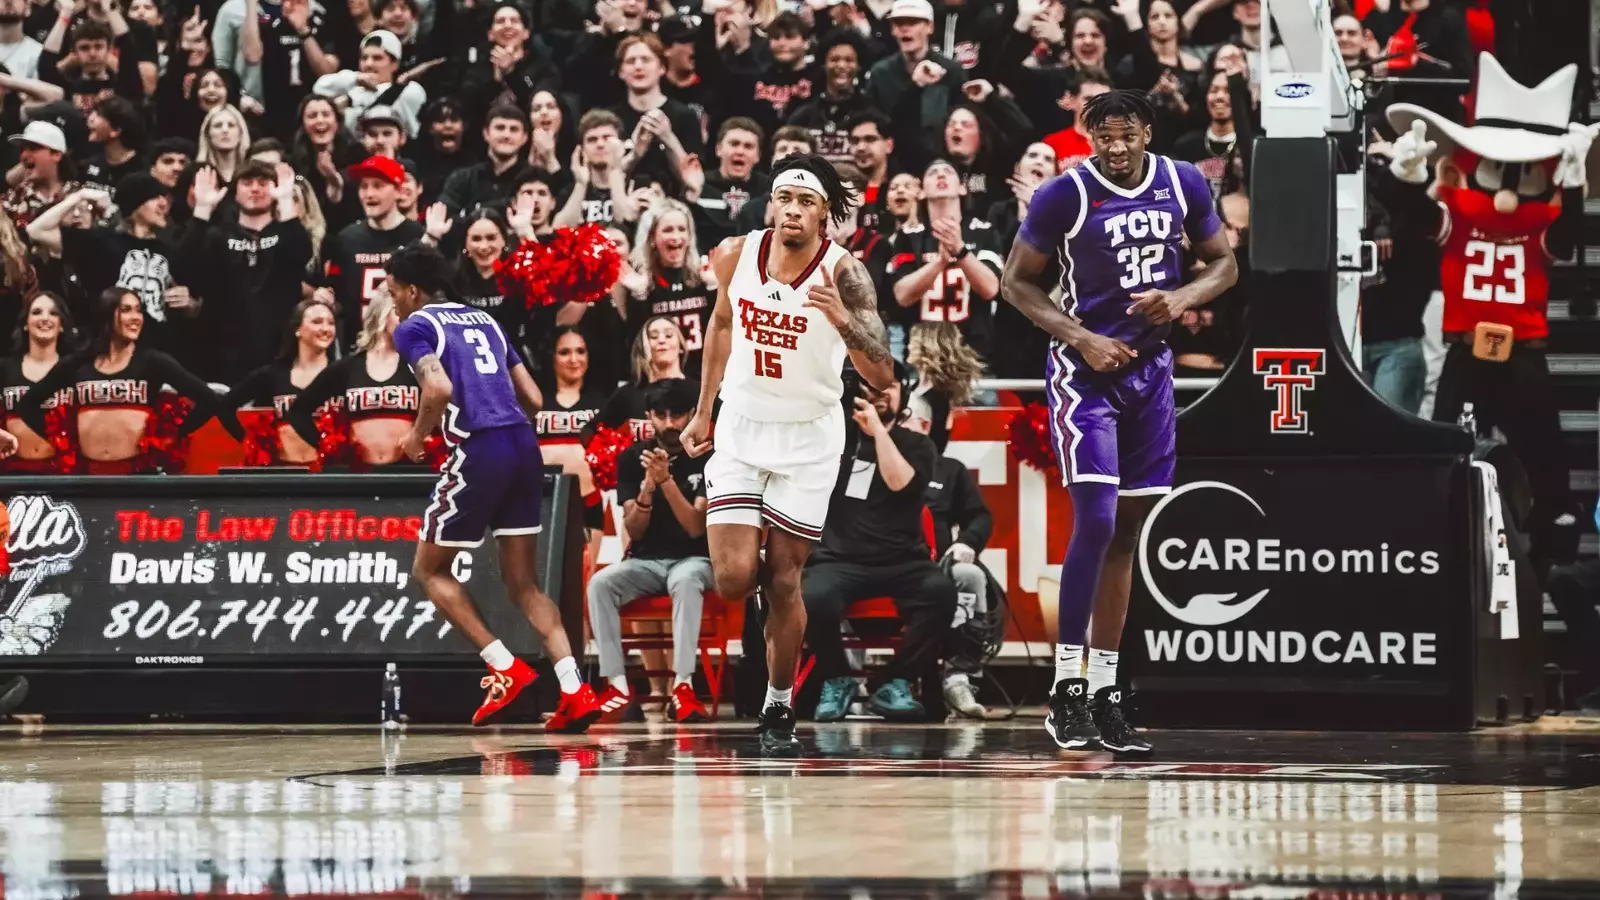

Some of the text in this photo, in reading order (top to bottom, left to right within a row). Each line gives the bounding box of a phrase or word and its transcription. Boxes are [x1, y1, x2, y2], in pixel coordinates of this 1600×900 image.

[1104, 210, 1172, 247] TCU
[1117, 244, 1166, 289] 32
[1462, 240, 1525, 305] 23
[921, 267, 970, 321] 23
[738, 297, 808, 334] TEXAS
[463, 328, 499, 375] 3
[741, 320, 798, 350] TECH
[754, 348, 782, 379] 15
[76, 379, 148, 405] TECH
[346, 385, 419, 412] TECH
[5, 500, 74, 553] lla
[115, 509, 424, 542] The Law Offices
[109, 552, 216, 584] Davis
[228, 552, 273, 584] W.
[285, 551, 408, 589] Smith,
[1158, 538, 1440, 574] CAREnomics
[102, 596, 453, 642] 806.744.447
[135, 656, 204, 664] DAKTRONICS
[1145, 629, 1437, 665] WOUNDCARE
